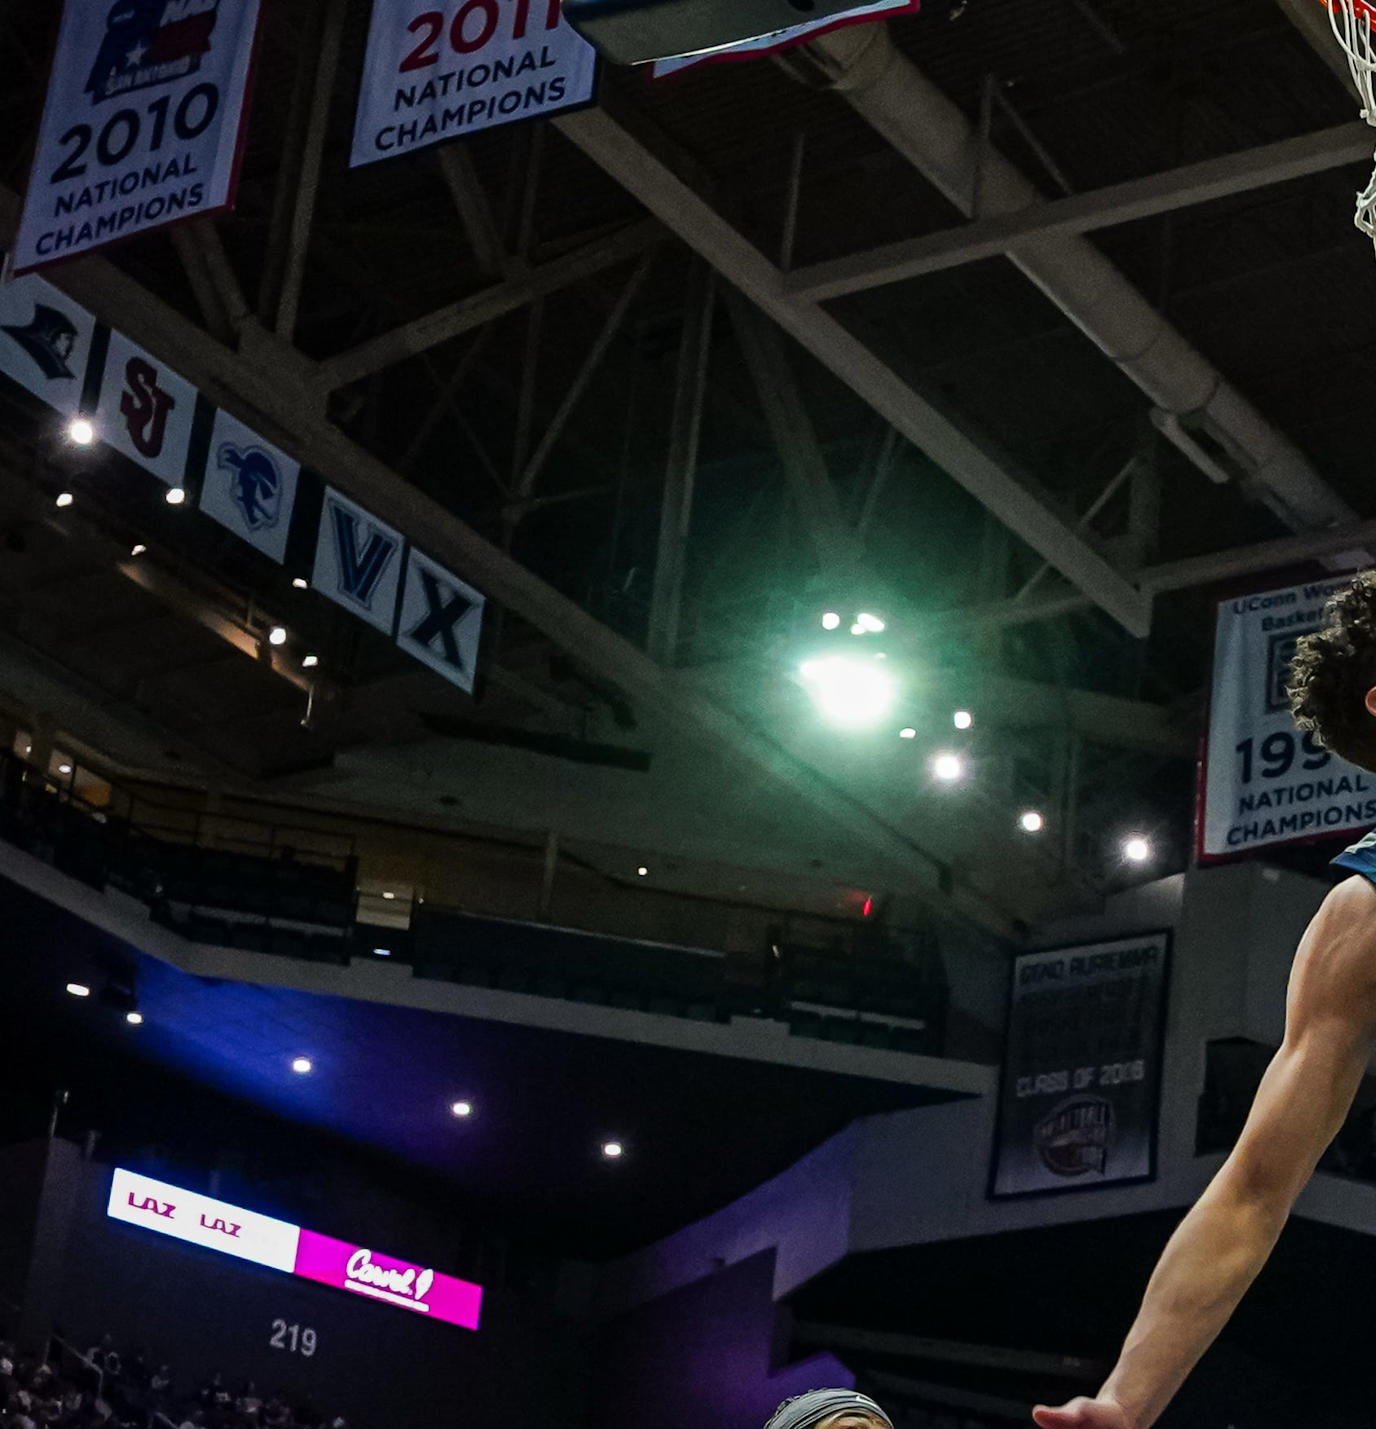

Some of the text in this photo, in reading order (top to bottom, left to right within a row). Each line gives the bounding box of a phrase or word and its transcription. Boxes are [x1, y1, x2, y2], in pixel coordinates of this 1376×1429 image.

[394, 45, 557, 112] NATIONAL
[50, 82, 220, 185] 2010
[374, 77, 567, 151] CHAMPIONS
[54, 153, 197, 218] NATIONAL
[35, 183, 204, 256] CHAMPIONS
[1233, 588, 1298, 615] UConn
[1234, 731, 1331, 785] 199
[1238, 774, 1369, 816] NATIONAL
[128, 1192, 242, 1238] LAZ LAZ
[269, 1318, 318, 1357] 219
